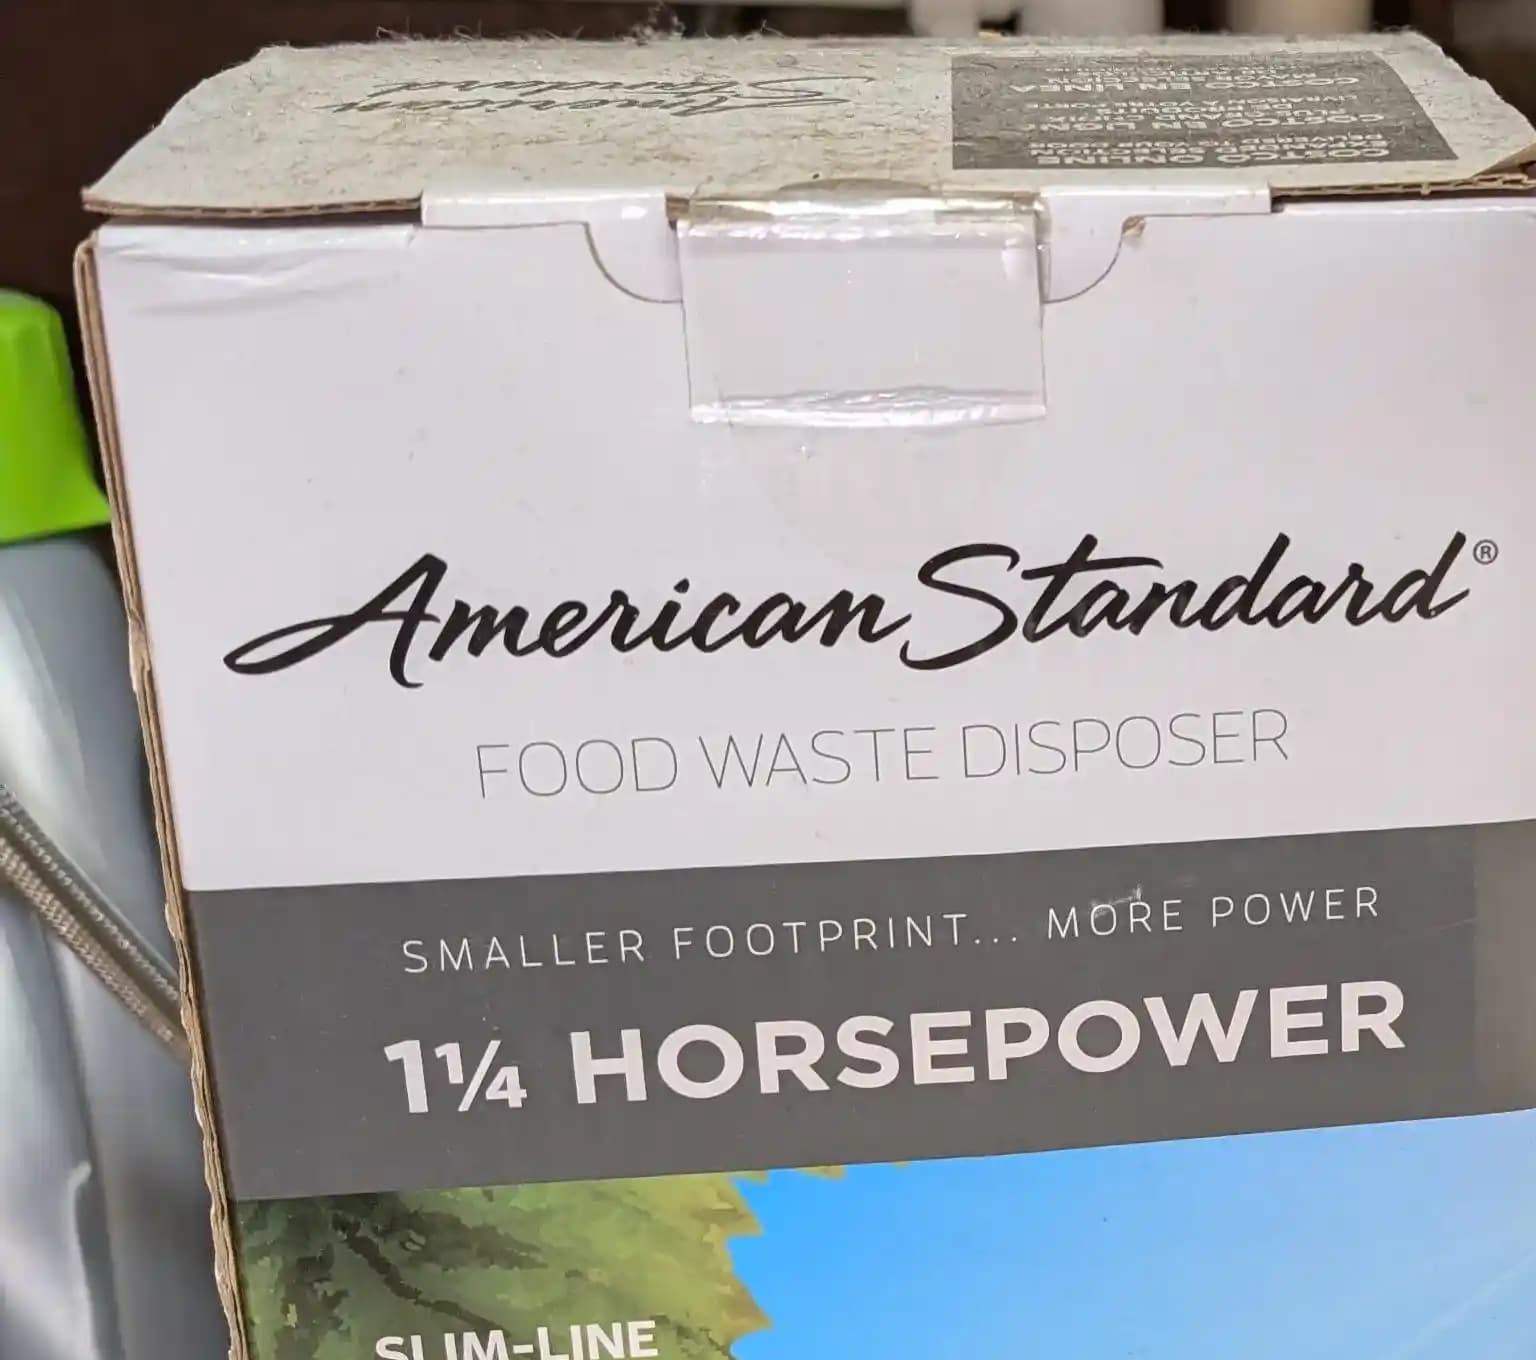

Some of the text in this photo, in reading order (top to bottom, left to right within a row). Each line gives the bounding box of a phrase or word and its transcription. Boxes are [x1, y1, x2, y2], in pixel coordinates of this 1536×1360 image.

[366, 76, 876, 99] Standard
[1204, 77, 1360, 89] COSTCO
[313, 96, 851, 117] American
[1151, 121, 1208, 130] EN
[1221, 114, 1385, 128] COSTCO
[1037, 148, 1390, 165] COSTCO ONLINE
[223, 552, 912, 689] American
[476, 708, 1289, 799] FOOD WASTE DISPOSER
[402, 886, 1379, 974] SMALLER FOOTPRINT... MORE POWER
[569, 980, 1406, 1104] HORSEPOWER
